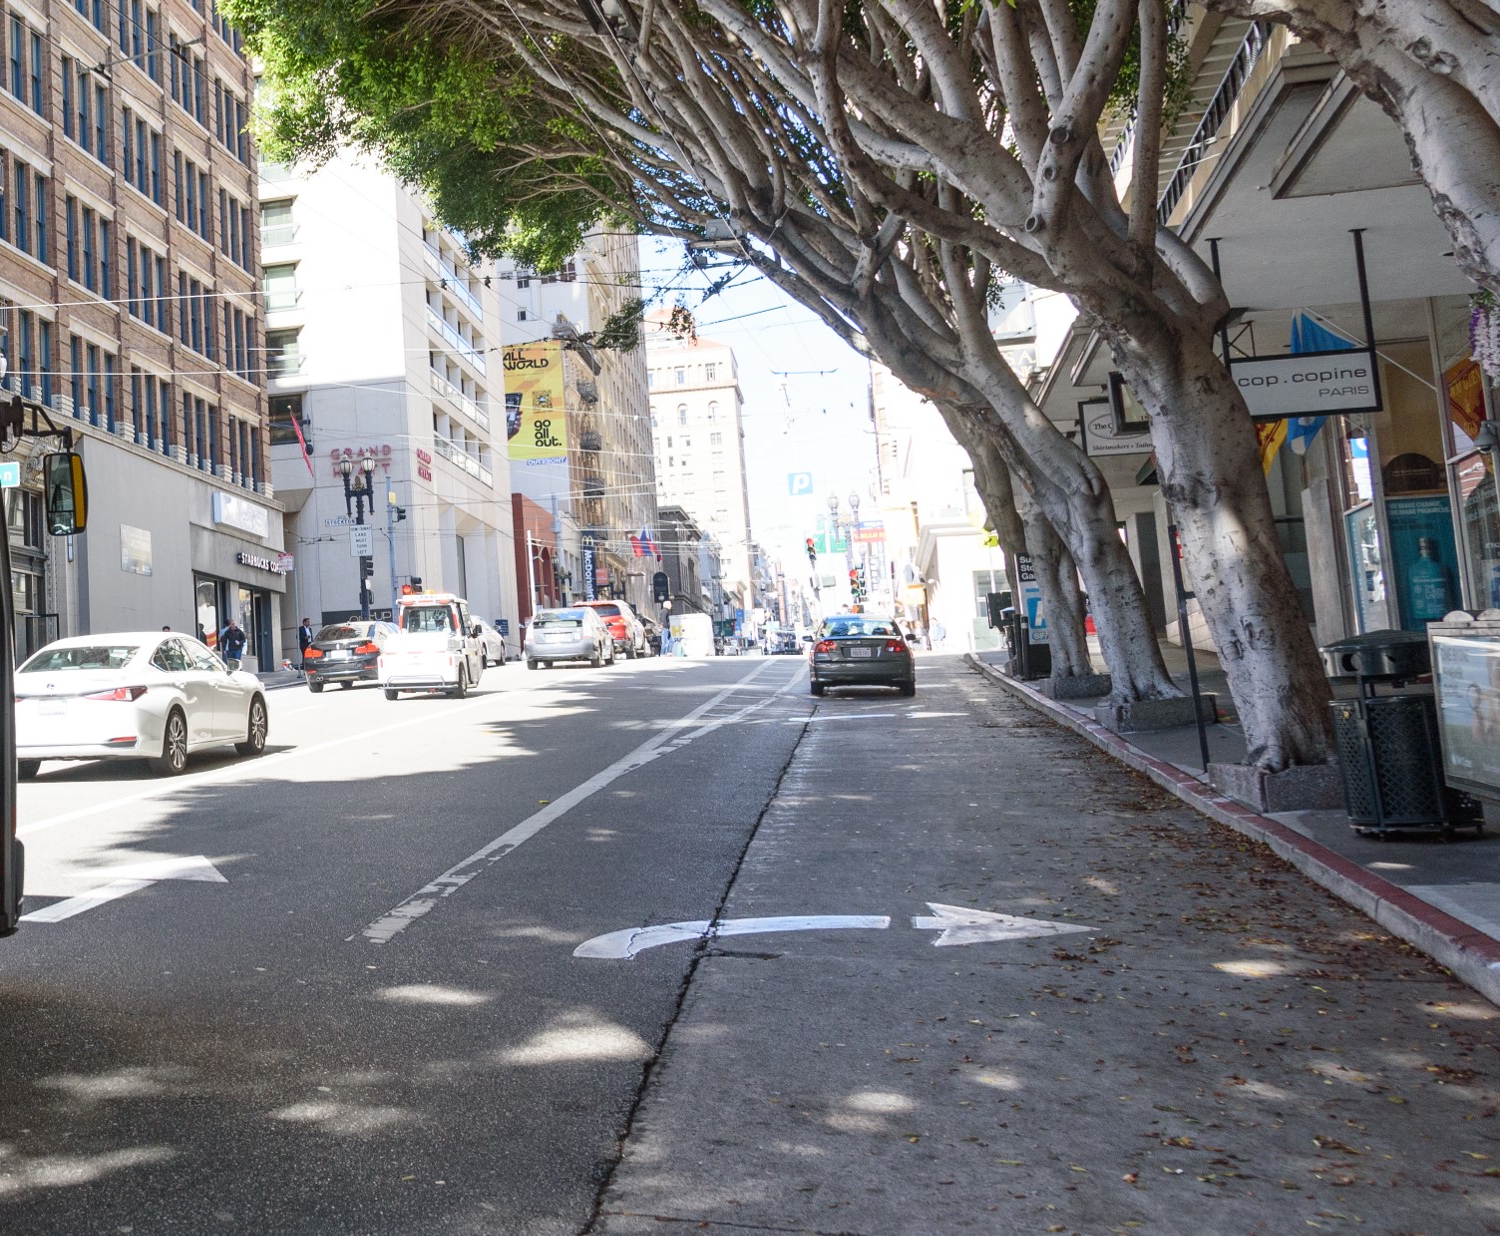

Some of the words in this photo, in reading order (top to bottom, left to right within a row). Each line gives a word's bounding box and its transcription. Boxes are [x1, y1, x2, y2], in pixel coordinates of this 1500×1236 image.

[503, 358, 549, 370] WORLD
[1318, 385, 1369, 397] PARIS
[534, 419, 551, 431] go
[535, 428, 549, 438] all
[535, 436, 563, 447] out.
[330, 444, 392, 460] GRAND
[792, 474, 810, 495] P
[241, 552, 269, 571] STARBUCKS
